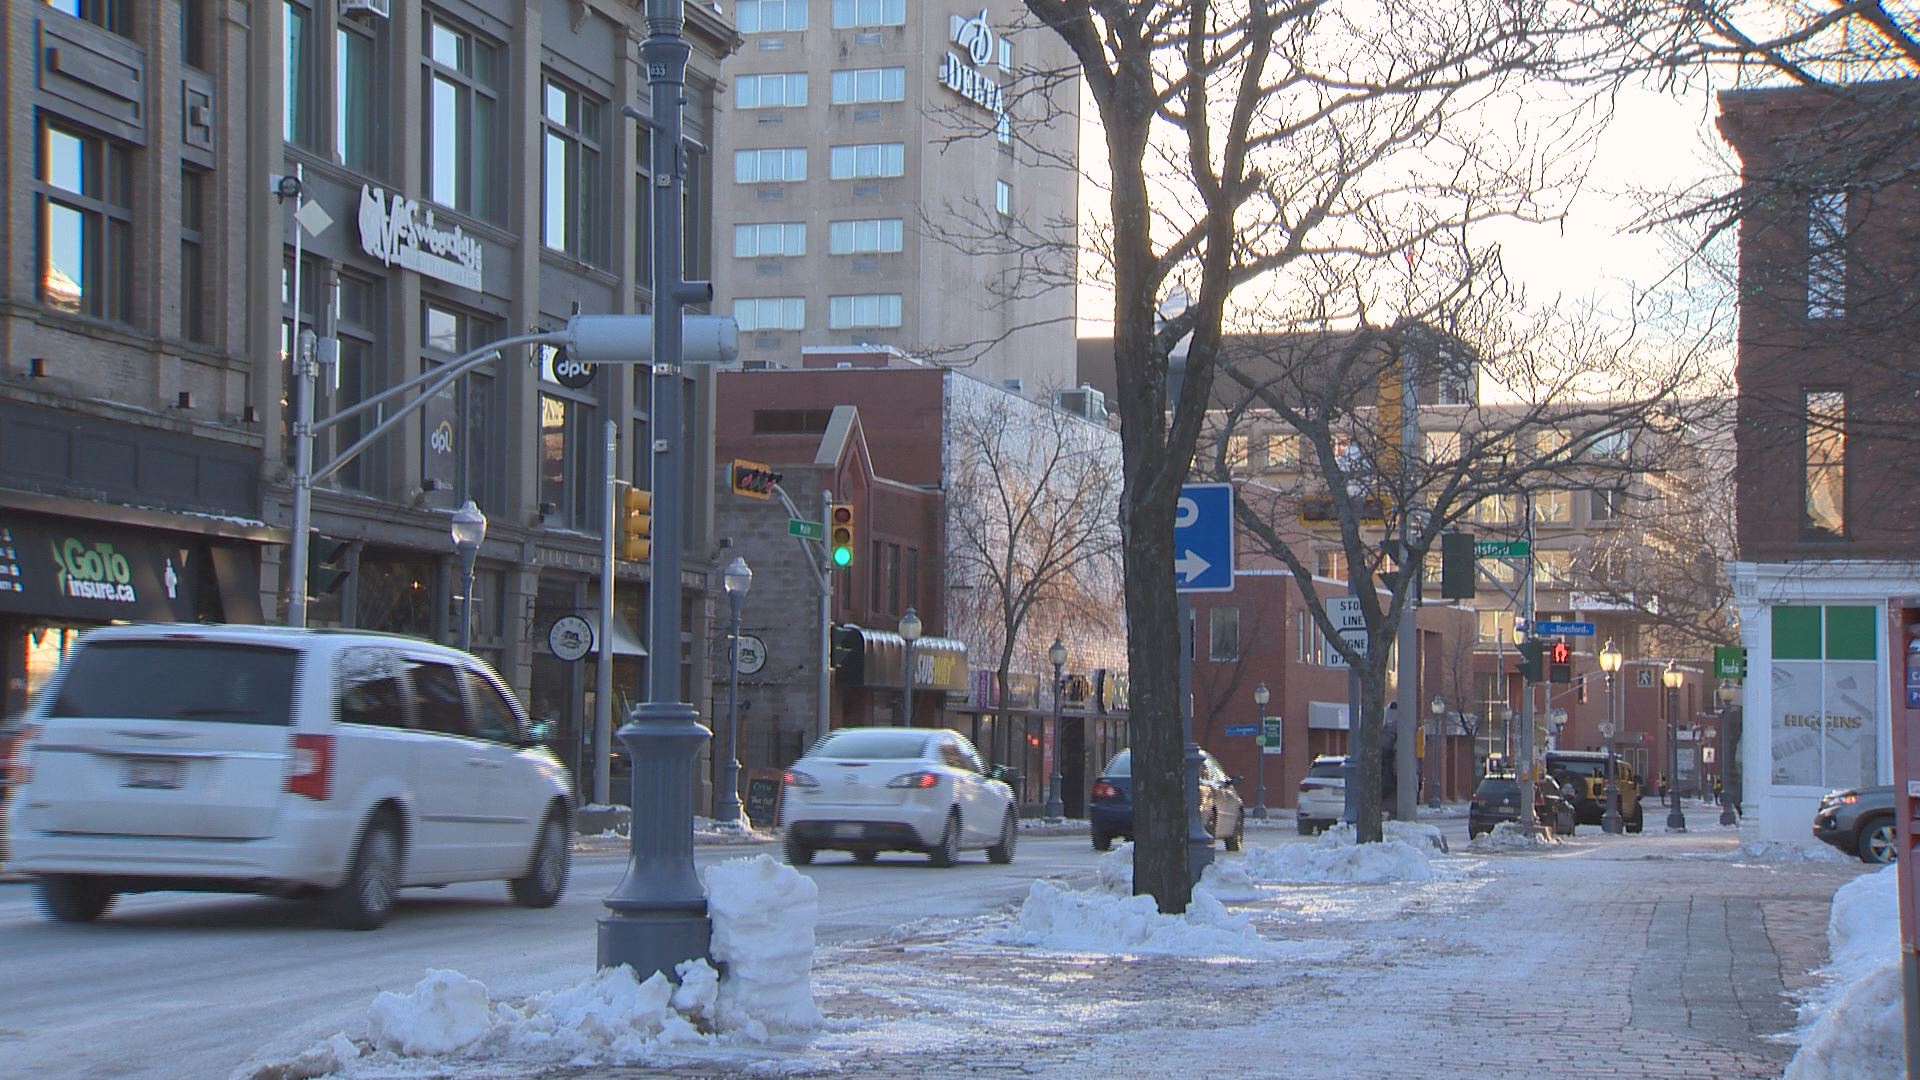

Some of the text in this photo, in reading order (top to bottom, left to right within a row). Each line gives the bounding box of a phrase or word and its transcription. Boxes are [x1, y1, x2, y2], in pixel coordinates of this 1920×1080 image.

[946, 51, 1004, 114] DELTA
[63, 537, 131, 584] GoTo
[67, 573, 136, 603] insure.ca
[1340, 601, 1362, 611] STO
[1342, 615, 1364, 626] LINE
[914, 653, 956, 685] SUBWAY
[1784, 714, 1862, 729] HIGGINS
